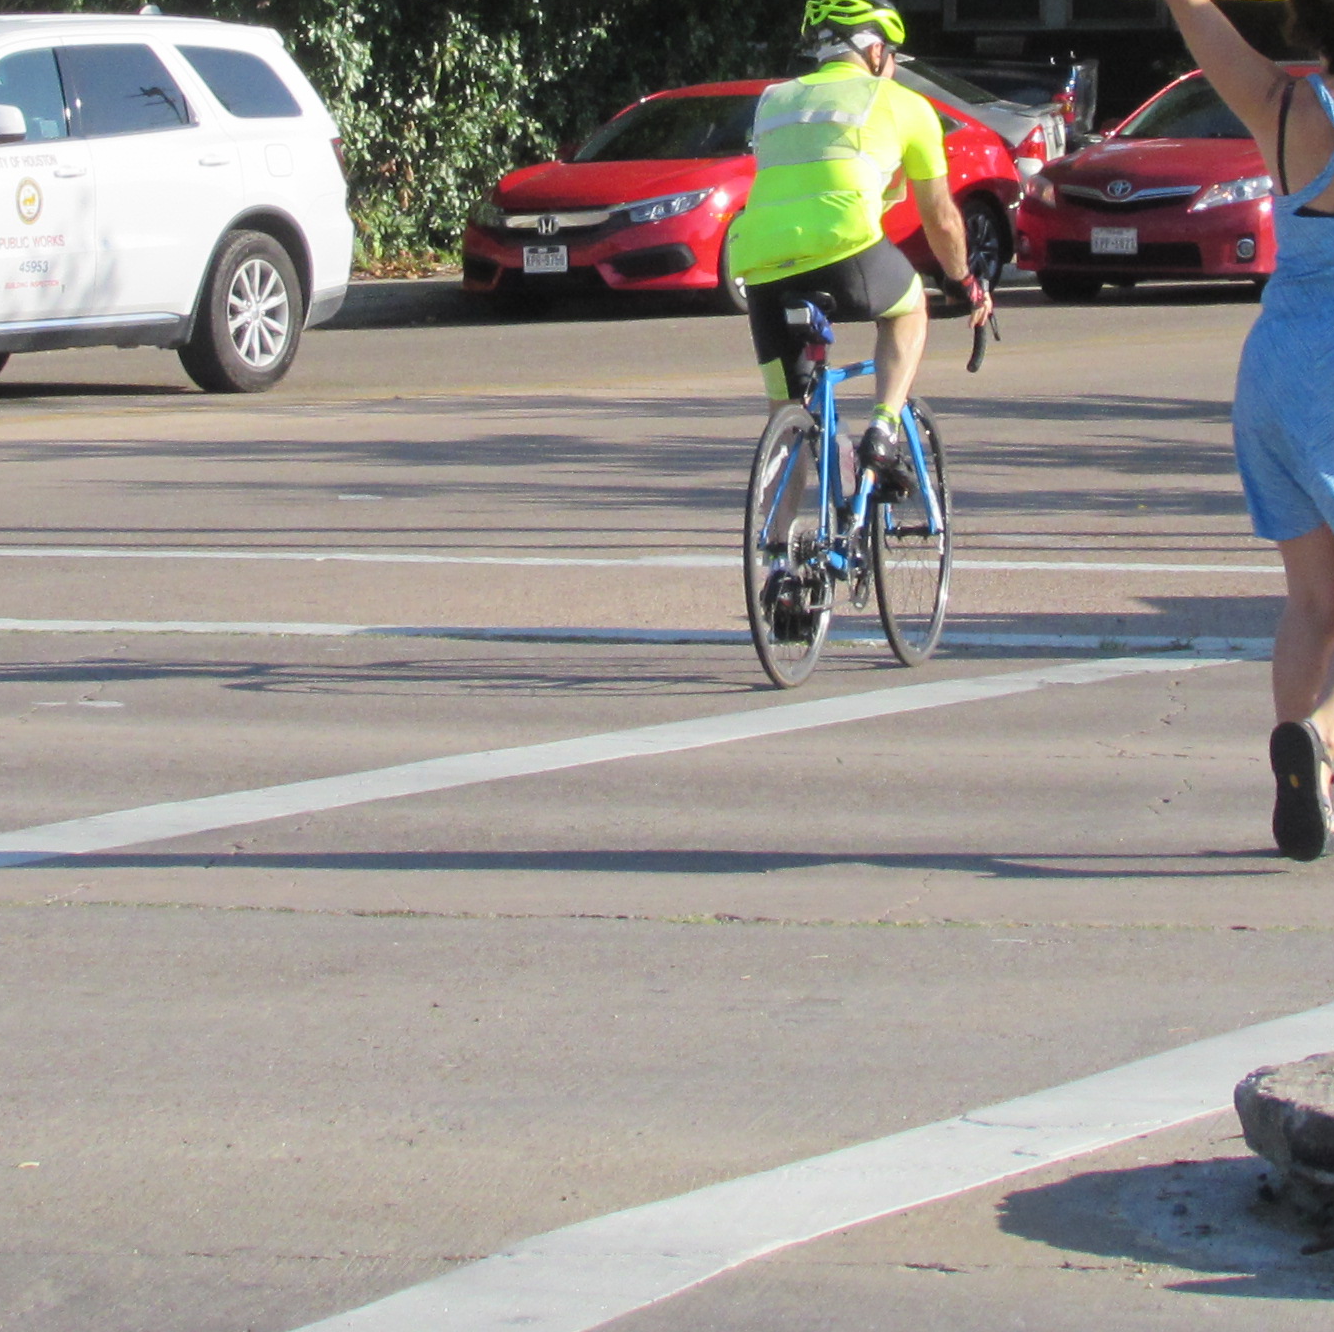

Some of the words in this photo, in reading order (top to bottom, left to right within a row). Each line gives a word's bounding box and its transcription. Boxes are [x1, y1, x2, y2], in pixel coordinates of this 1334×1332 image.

[9, 155, 21, 168] OF
[22, 154, 58, 168] HOUSTON
[32, 234, 65, 248] WORKS
[19, 260, 49, 274] 45953
